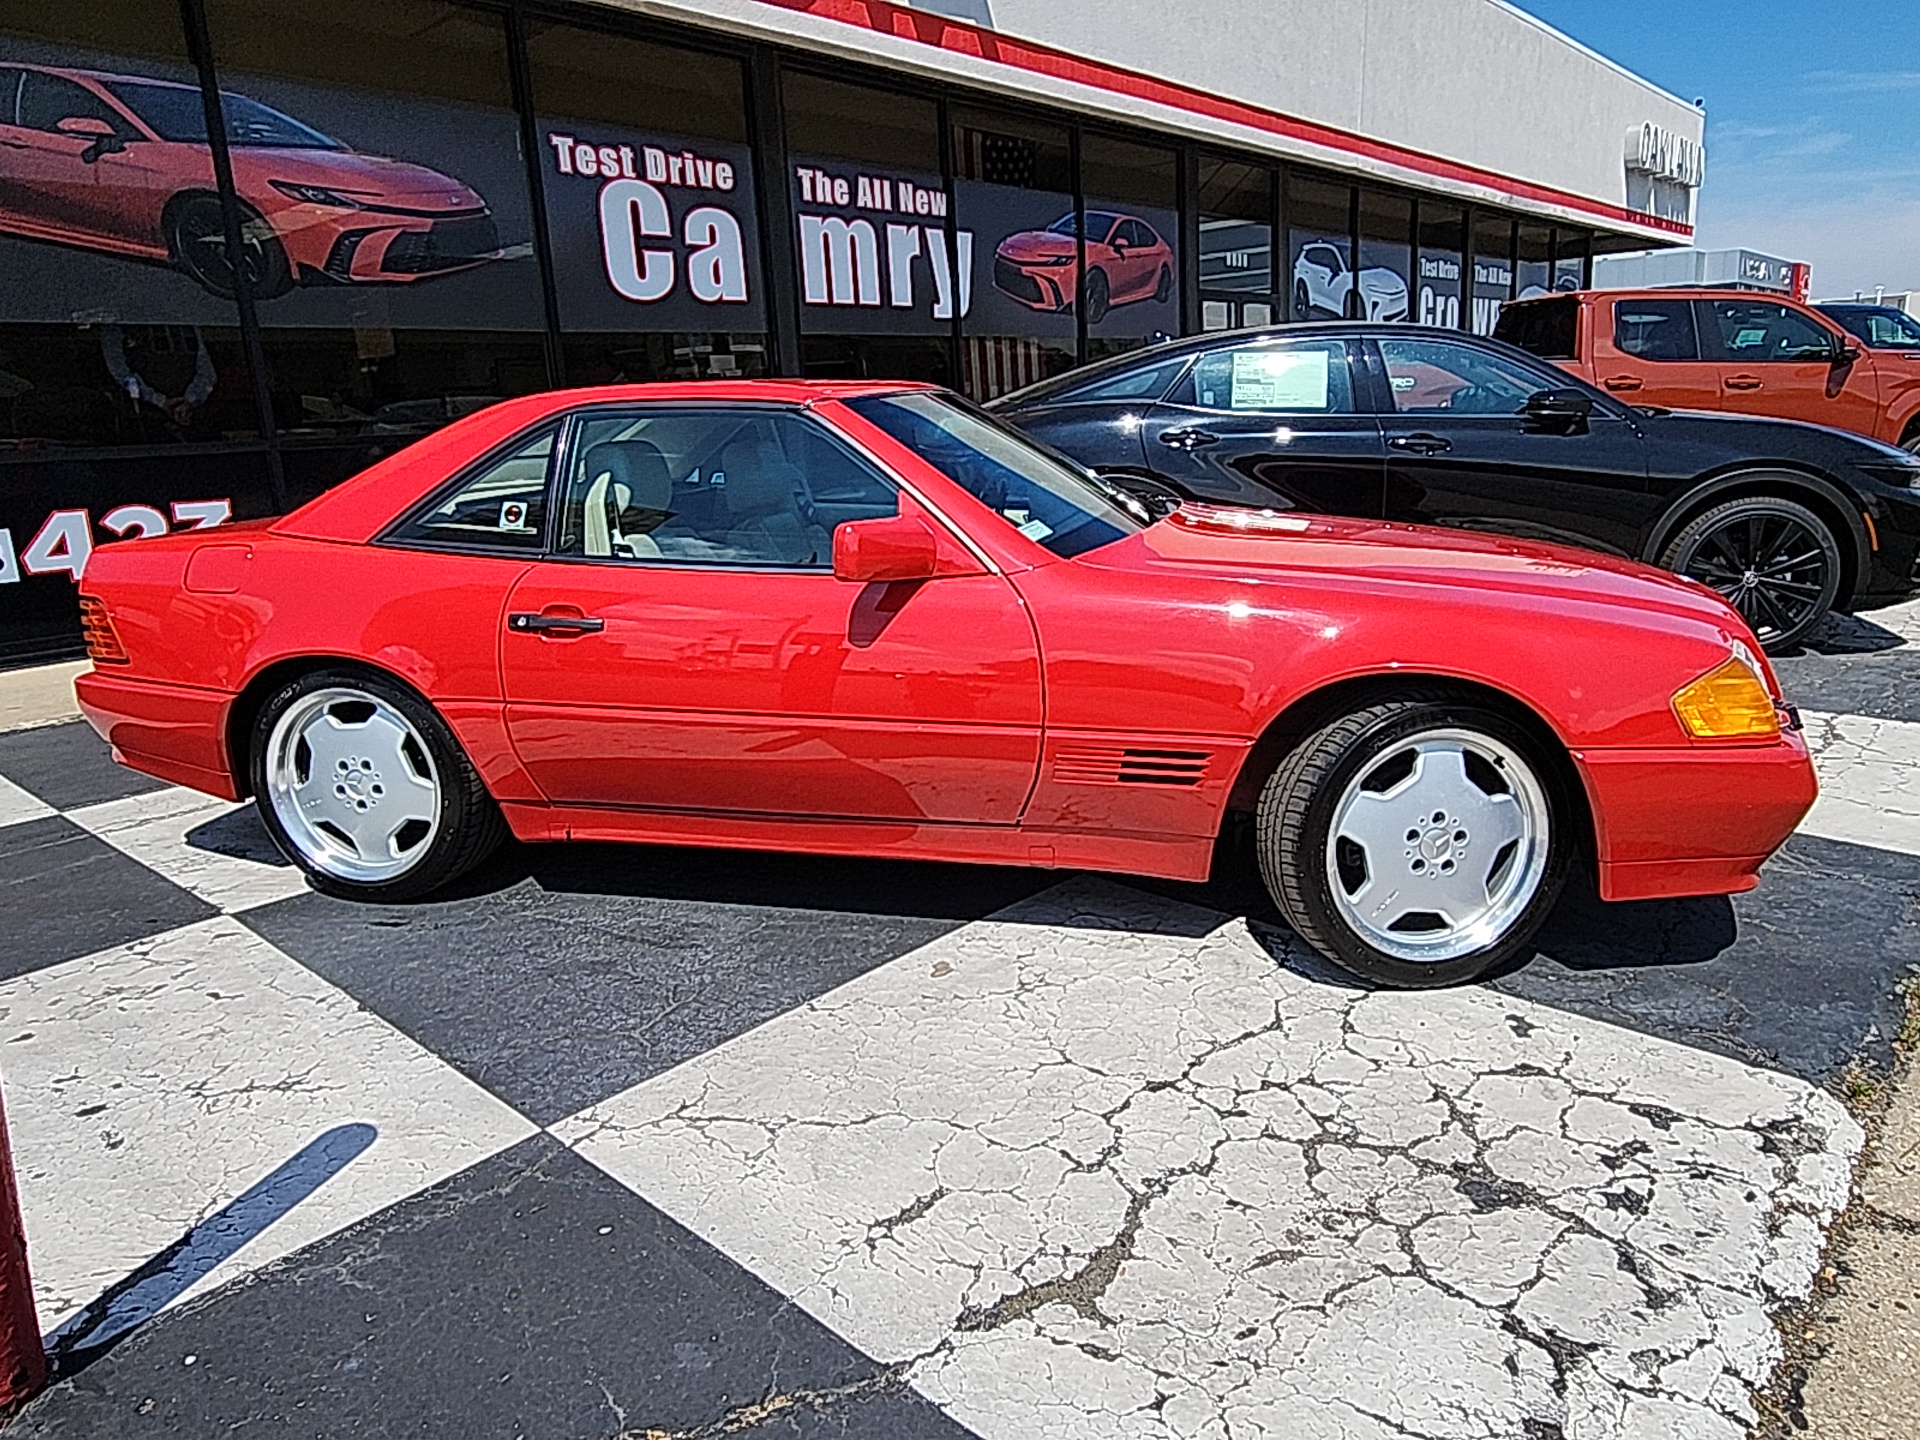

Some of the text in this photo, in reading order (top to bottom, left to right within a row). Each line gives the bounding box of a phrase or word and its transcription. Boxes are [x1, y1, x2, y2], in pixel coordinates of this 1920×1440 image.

[549, 133, 736, 191] Test Drive
[797, 166, 947, 217] The All New
[1420, 256, 1460, 281] Test Drive
[1474, 264, 1513, 287] The All New
